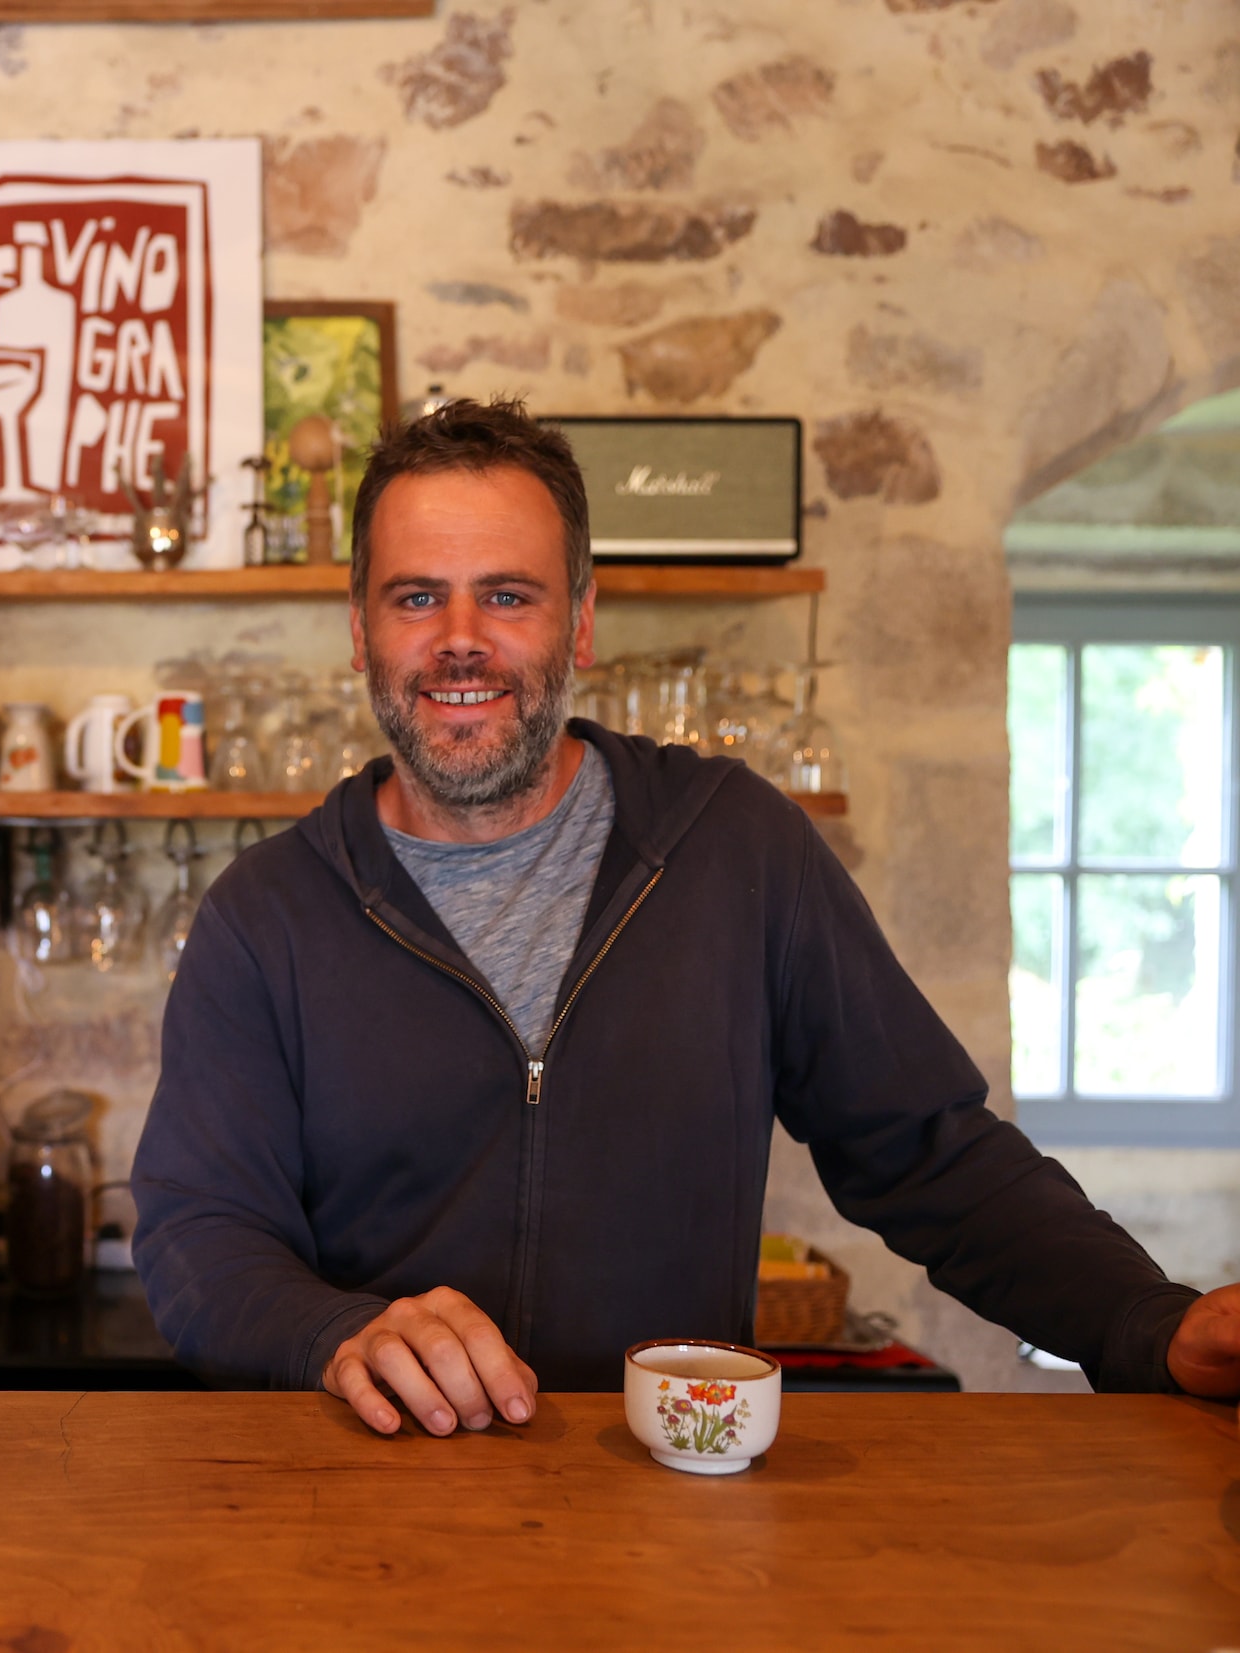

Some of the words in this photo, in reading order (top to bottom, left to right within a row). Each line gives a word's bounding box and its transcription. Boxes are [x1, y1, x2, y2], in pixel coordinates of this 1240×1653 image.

[77, 316, 184, 400] GRA
[66, 393, 182, 494] PHE
[615, 464, 721, 496] Marshall
